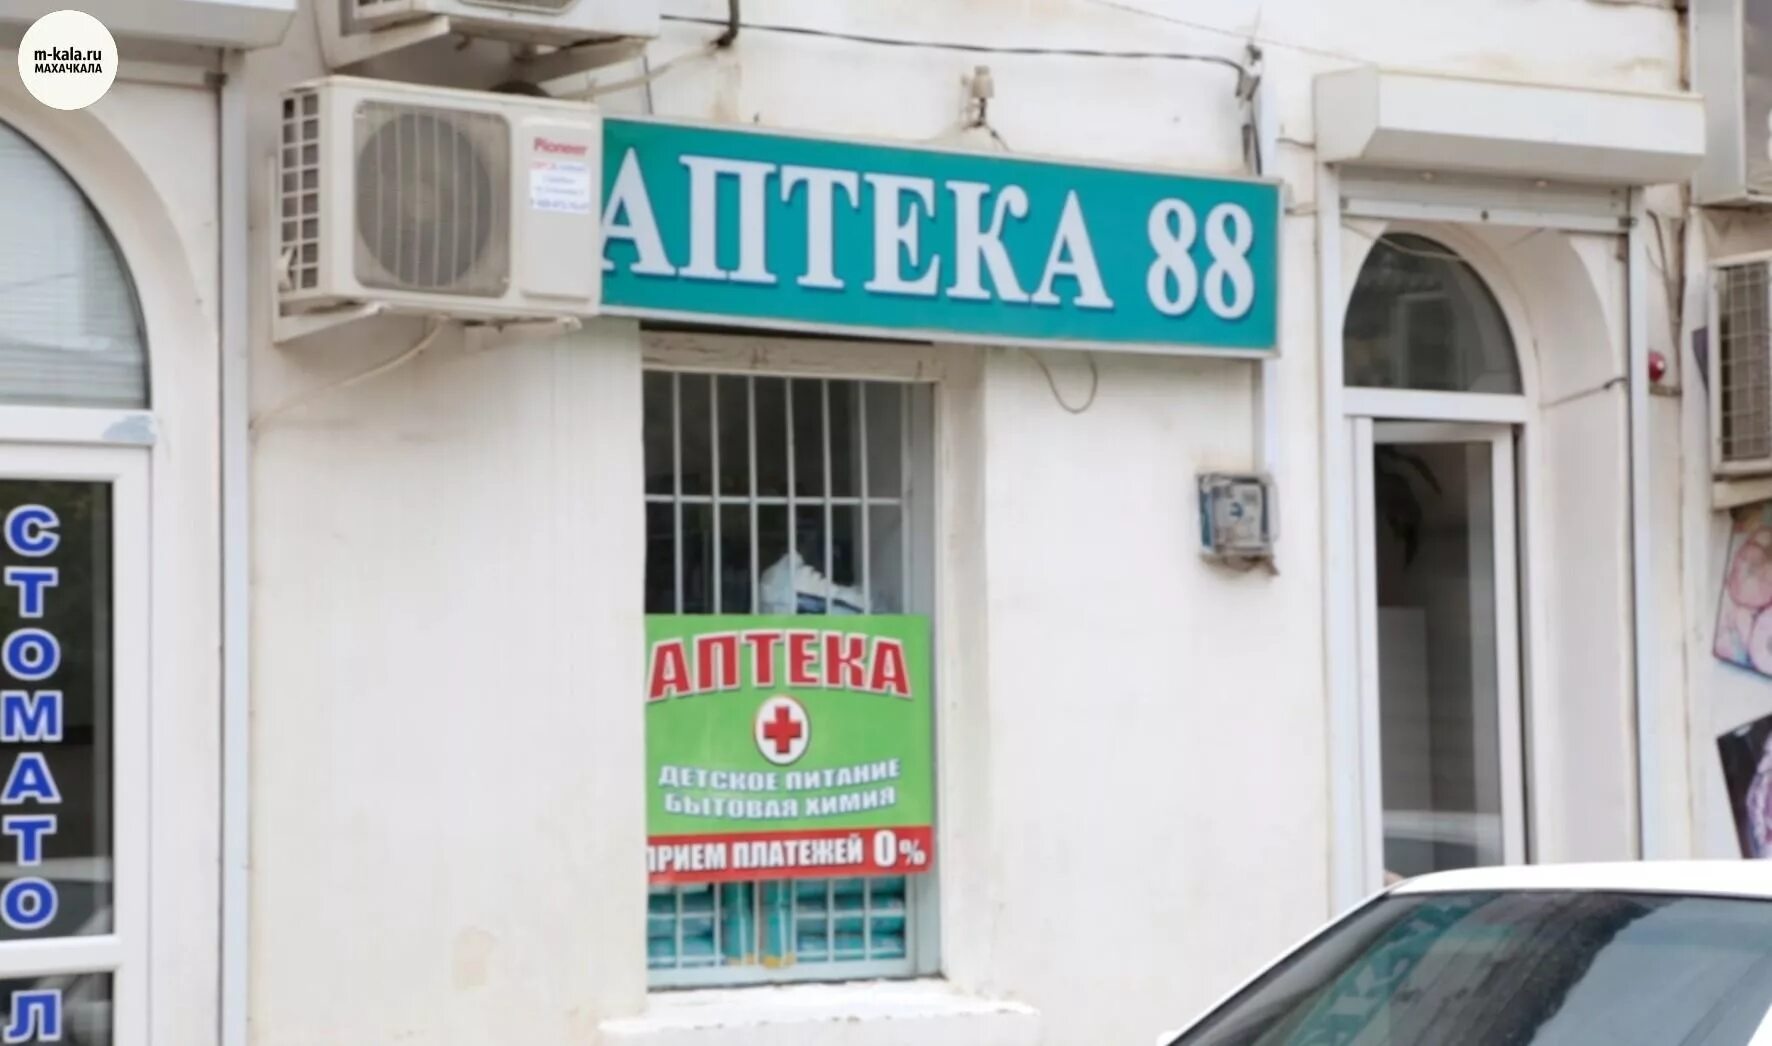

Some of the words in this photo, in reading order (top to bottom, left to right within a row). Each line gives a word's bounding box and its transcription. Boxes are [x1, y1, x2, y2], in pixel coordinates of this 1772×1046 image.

[602, 147, 1114, 310] АПТЕКА
[1146, 198, 1255, 319] 88
[648, 629, 913, 703] АПТЕКА
[658, 764, 780, 792] ДЕТСКОЕ
[785, 757, 902, 792] ПИТАНИЕ
[664, 793, 799, 819] БЫТОВАЯ
[804, 786, 897, 818] ХИМИЯ
[732, 833, 864, 869] ПЛАТЕЖЕЙ
